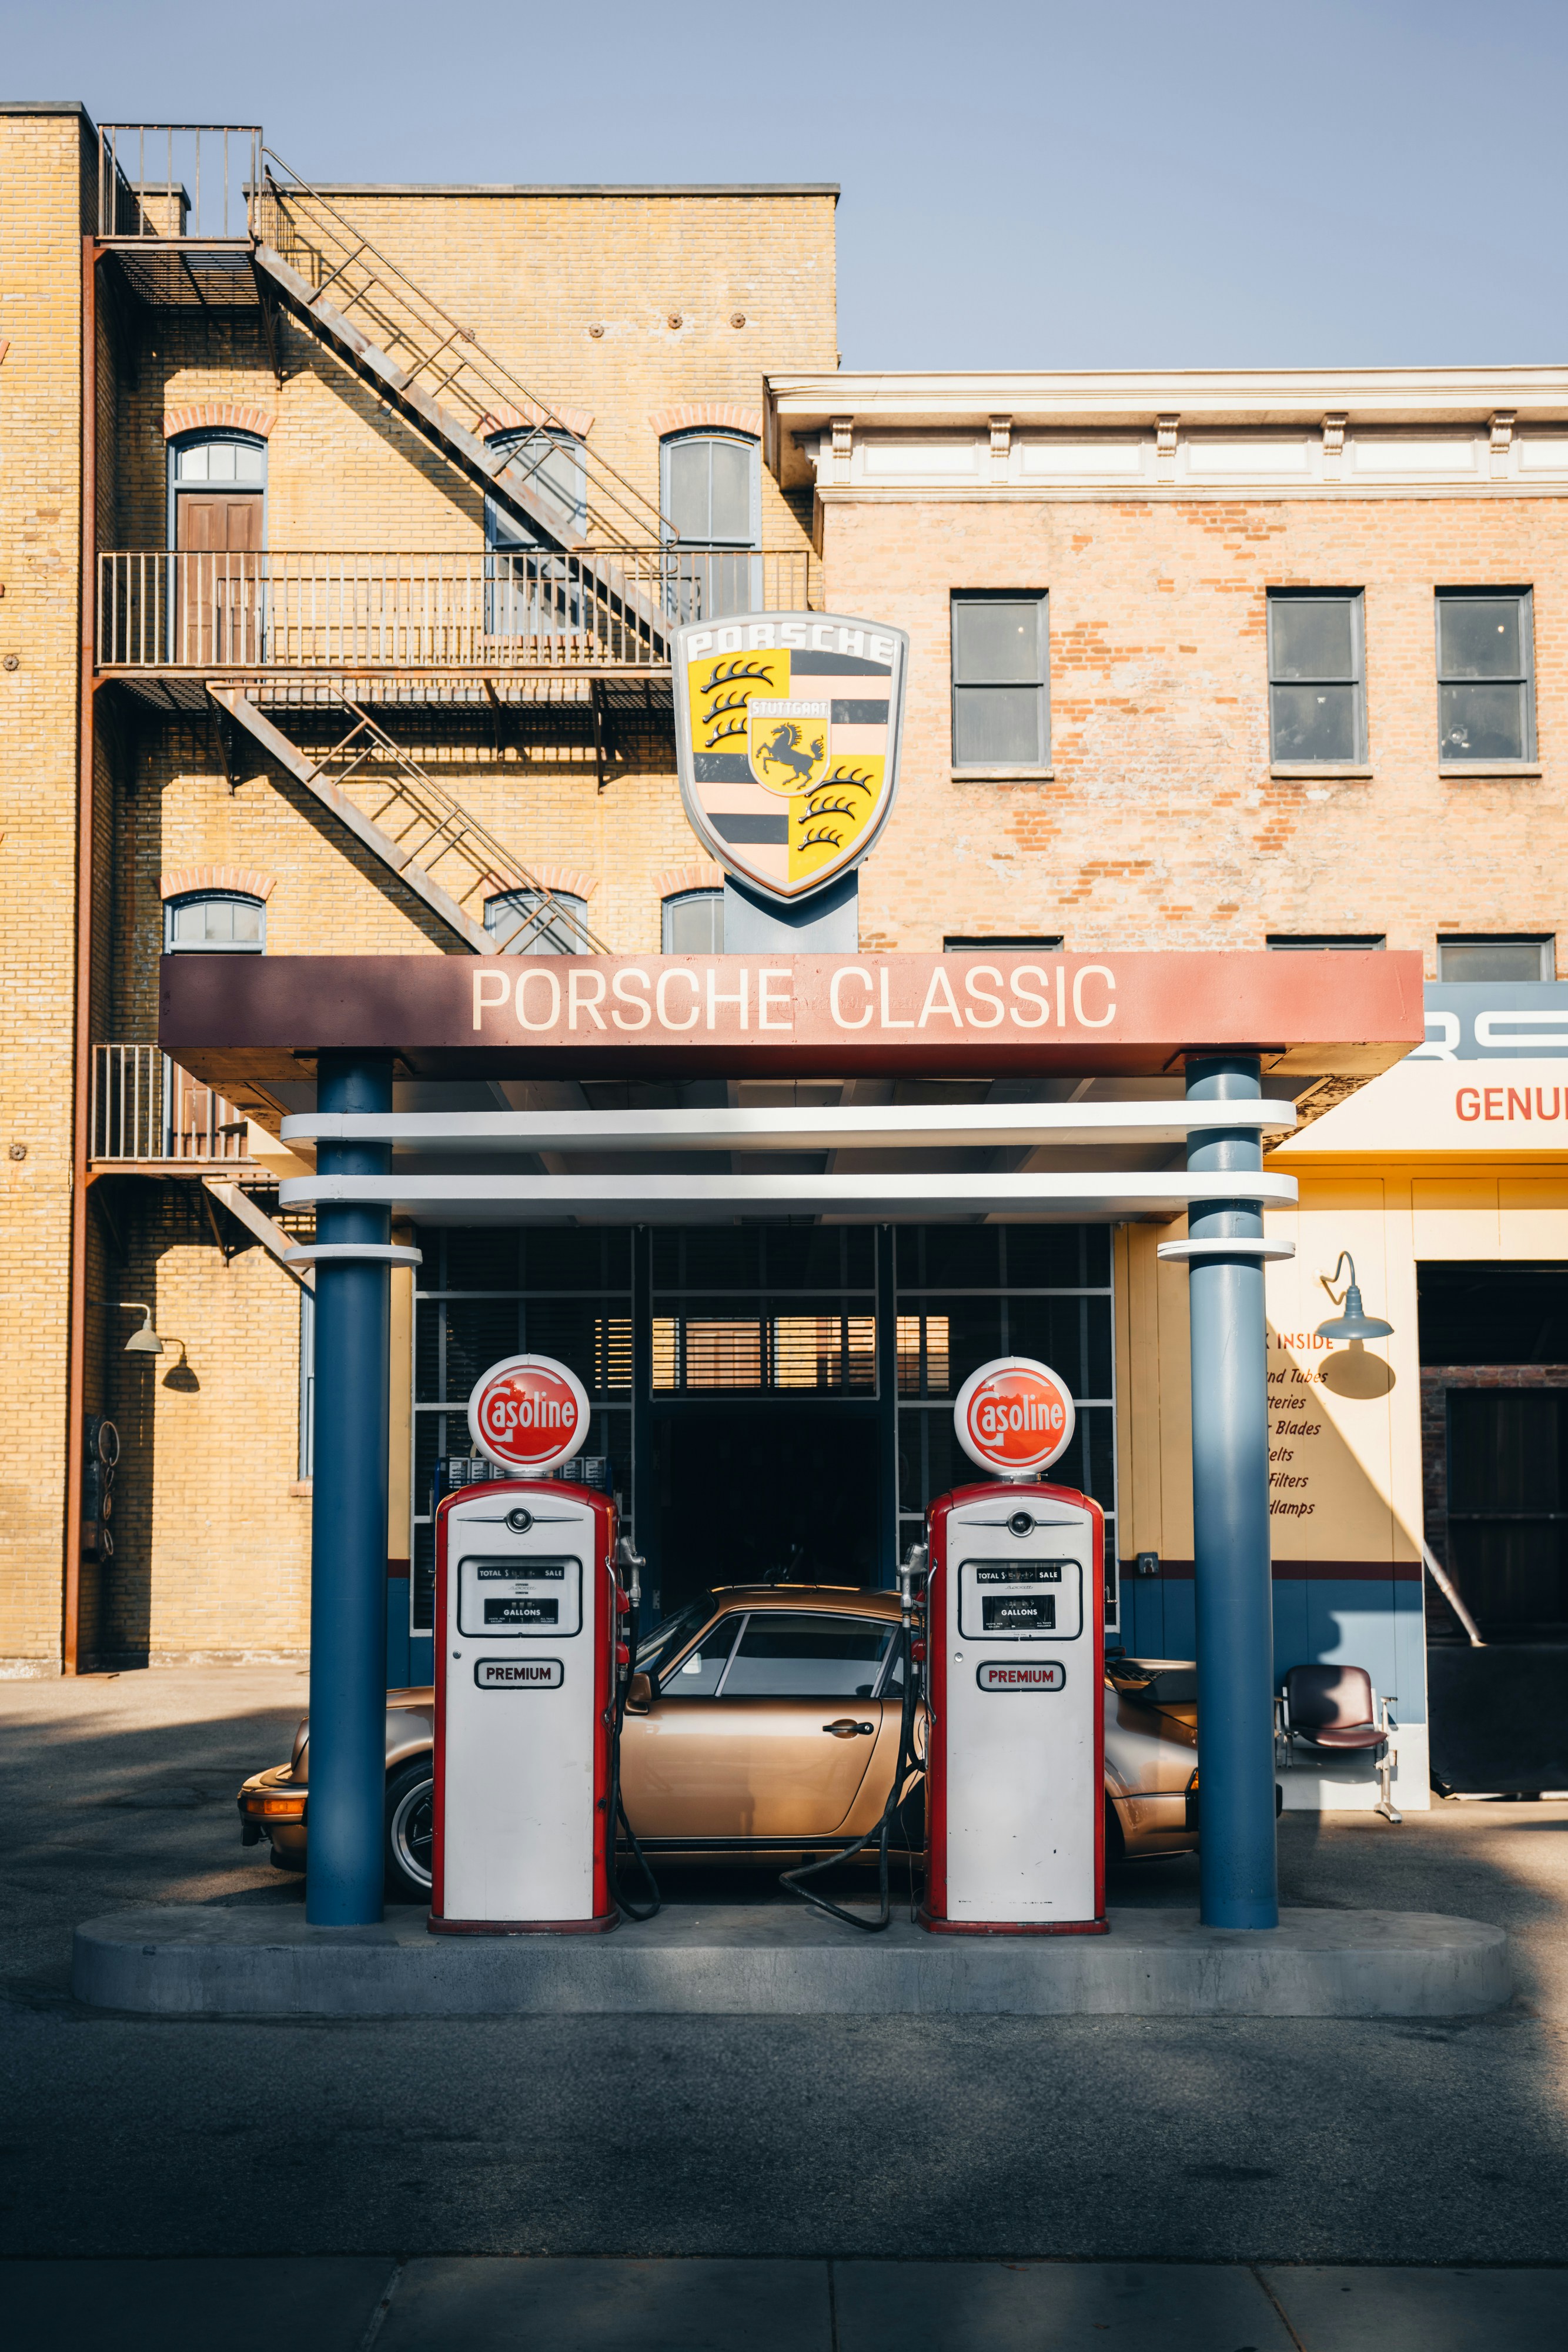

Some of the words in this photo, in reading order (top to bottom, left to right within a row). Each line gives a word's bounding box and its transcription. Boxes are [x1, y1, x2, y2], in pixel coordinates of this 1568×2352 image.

[687, 622, 894, 666] PORSCHE
[752, 701, 828, 716] STUTTGART
[472, 968, 793, 1031] PORSCHE
[831, 964, 1117, 1029] CLASSIC
[1277, 1333, 1333, 1349] INSIDE
[1267, 1368, 1287, 1383] nd
[1290, 1368, 1328, 1384] Tubes
[481, 1386, 576, 1442] Gasoline
[971, 1391, 1064, 1446] Gasoline
[1275, 1421, 1321, 1436] Blades
[1269, 1446, 1294, 1461] elts
[1269, 1472, 1309, 1488] Filters
[1001, 1571, 1005, 1580] $
[486, 1667, 551, 1680] PREMIUM
[989, 1670, 1054, 1683] PREMIUM
